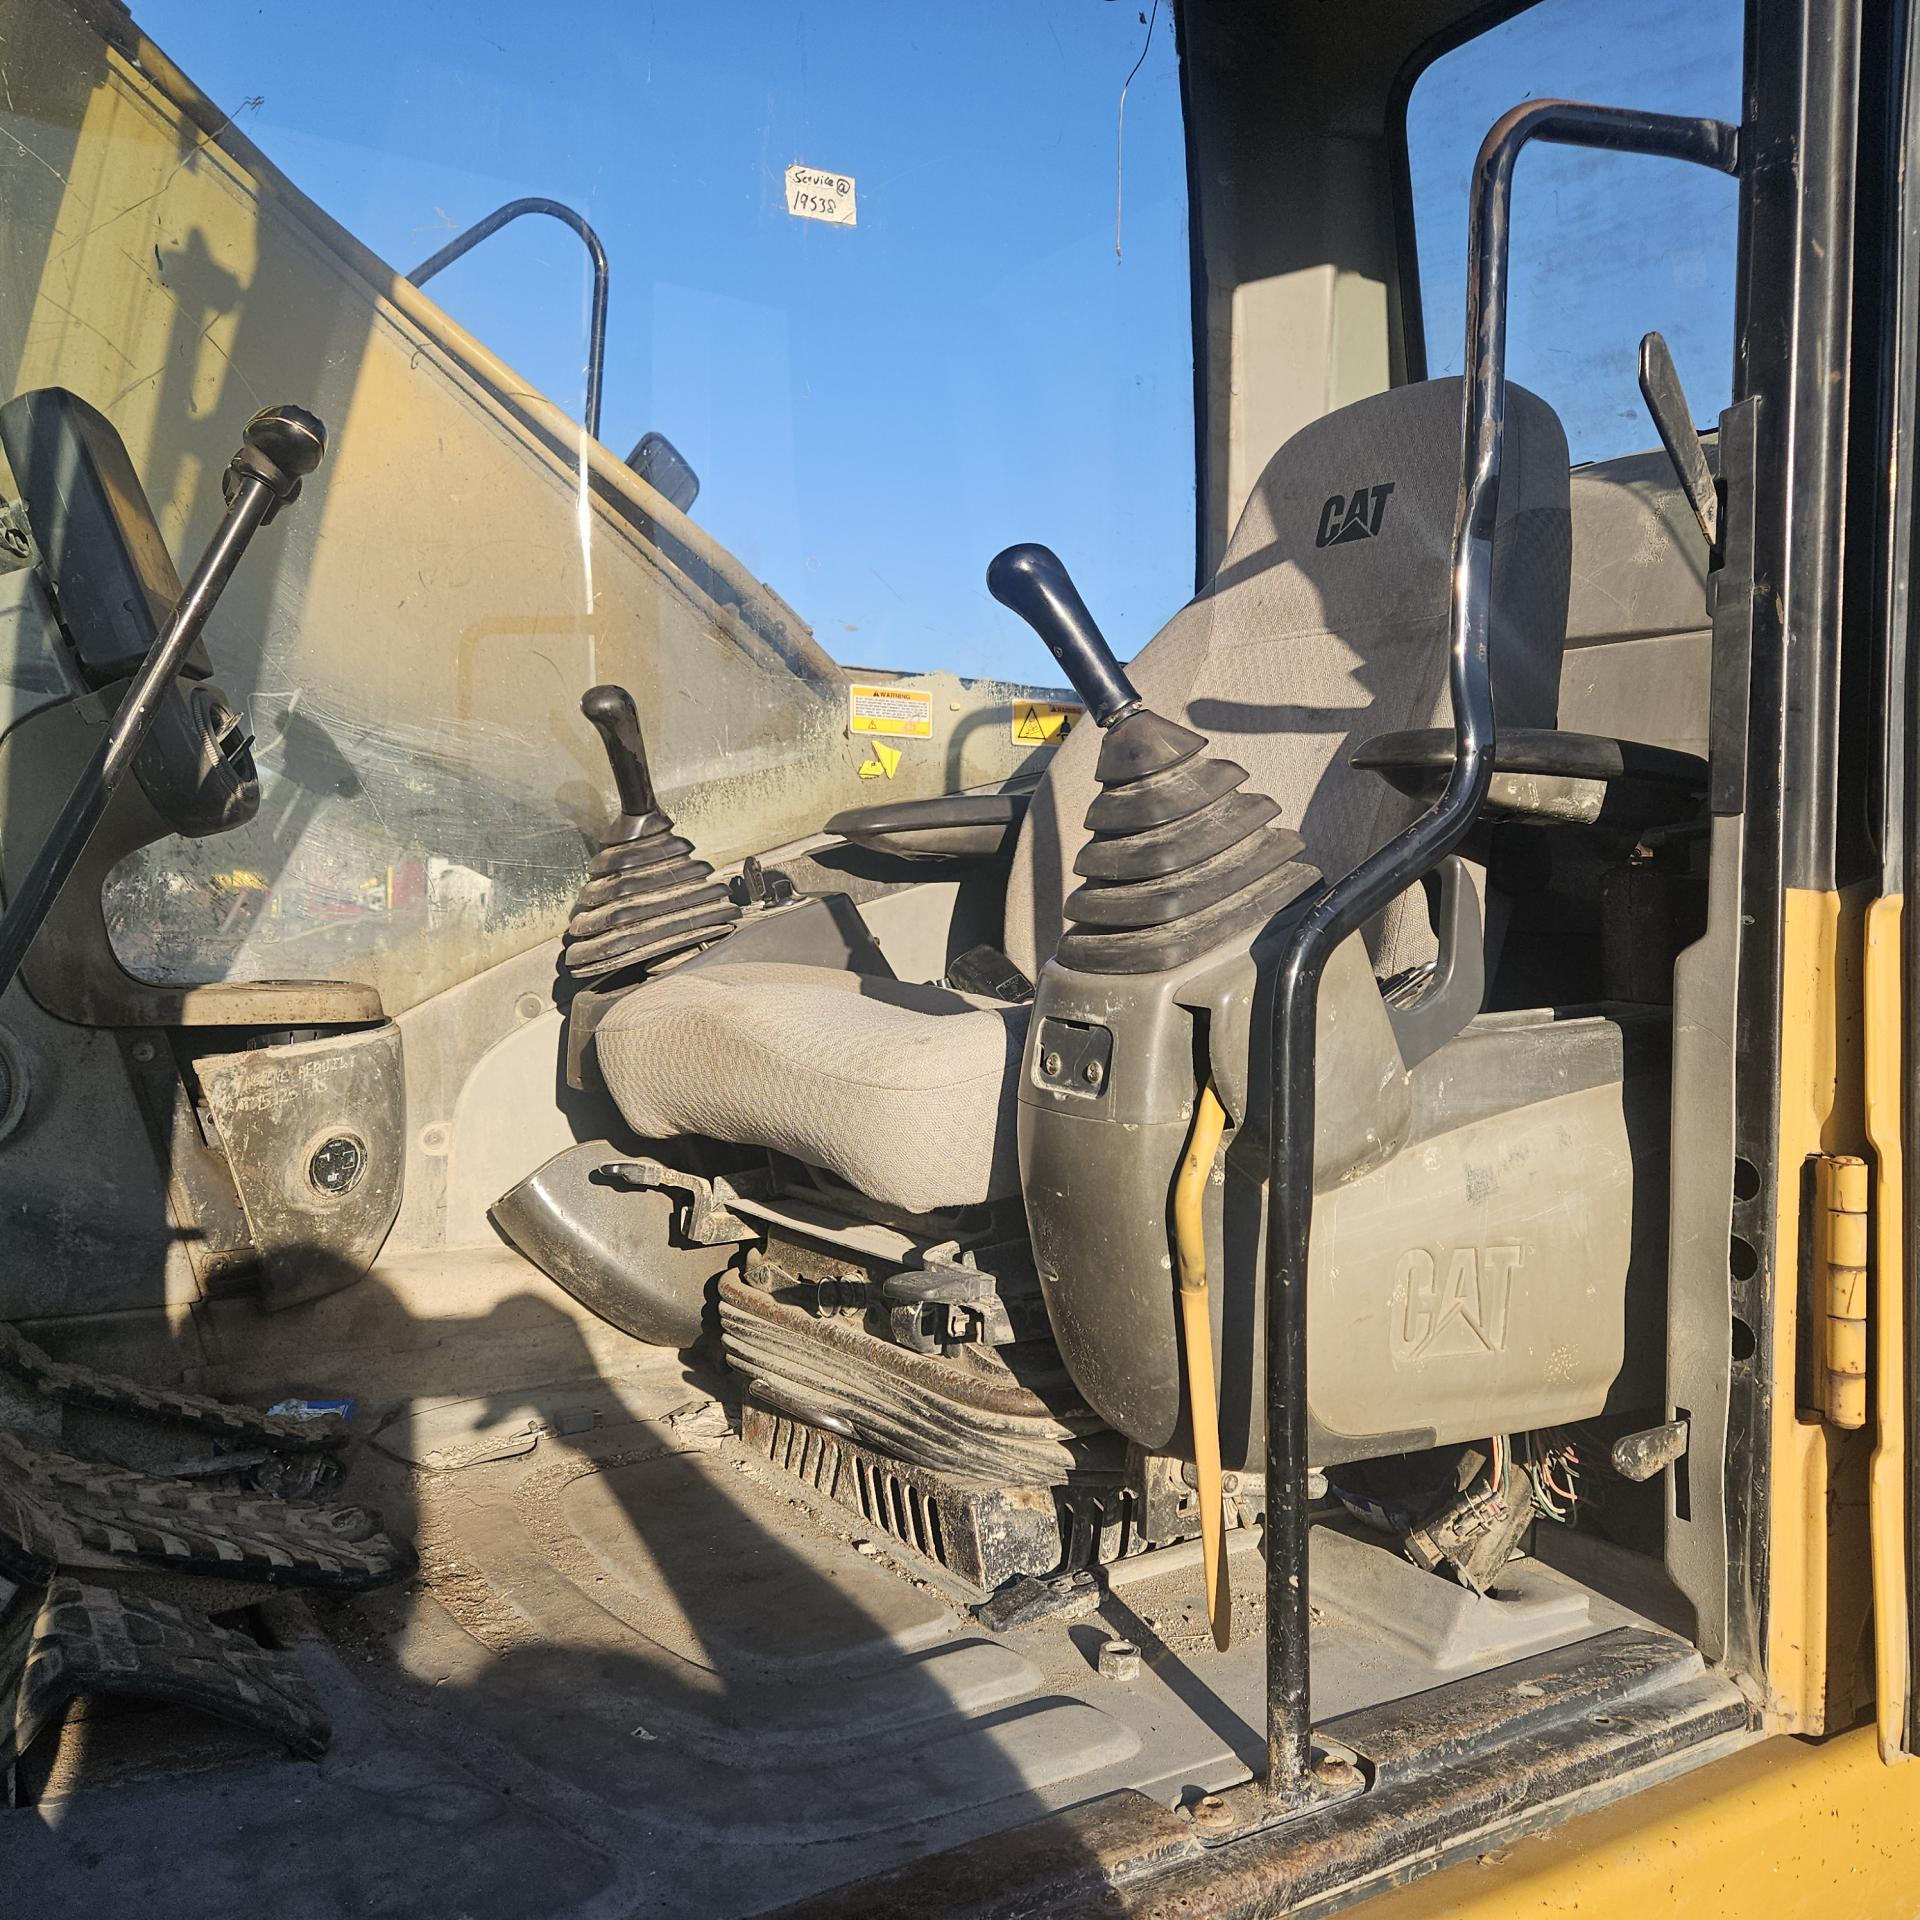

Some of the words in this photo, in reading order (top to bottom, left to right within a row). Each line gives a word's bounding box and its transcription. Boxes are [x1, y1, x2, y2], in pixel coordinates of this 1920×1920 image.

[793, 170, 834, 187] Service
[836, 178, 850, 197] @
[794, 191, 836, 214] 19538
[1315, 481, 1396, 548] CAT
[880, 691, 911, 700] WARNING
[1390, 1245, 1523, 1362] CAT
